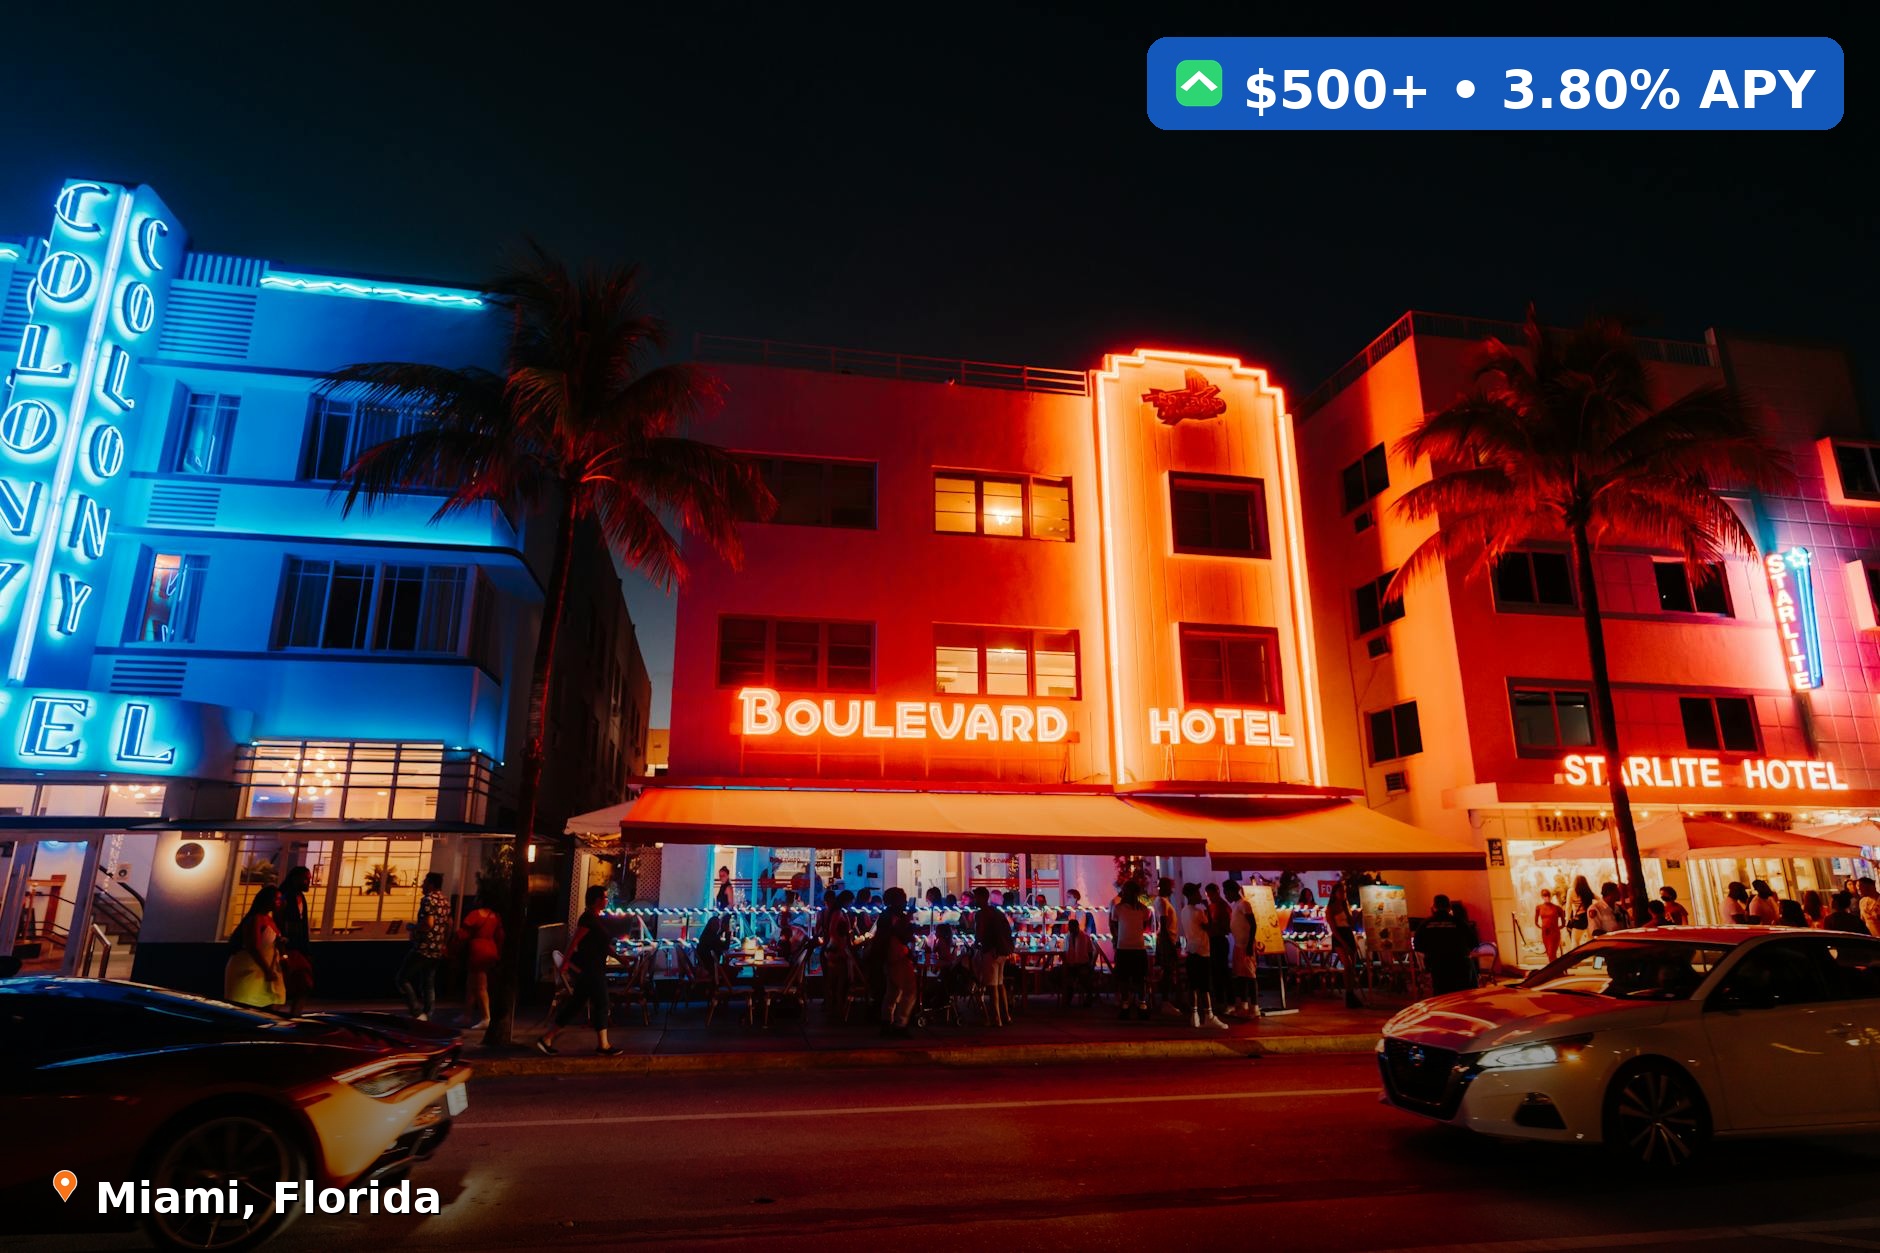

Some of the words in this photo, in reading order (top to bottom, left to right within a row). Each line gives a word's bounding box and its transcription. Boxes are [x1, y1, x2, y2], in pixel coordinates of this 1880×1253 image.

[57, 216, 168, 636] COLONY
[1766, 553, 1811, 690] STARLITE
[739, 687, 1068, 742] BOULEVARD
[1148, 706, 1294, 748] HOTEL
[1744, 759, 1848, 791] HOTEL
